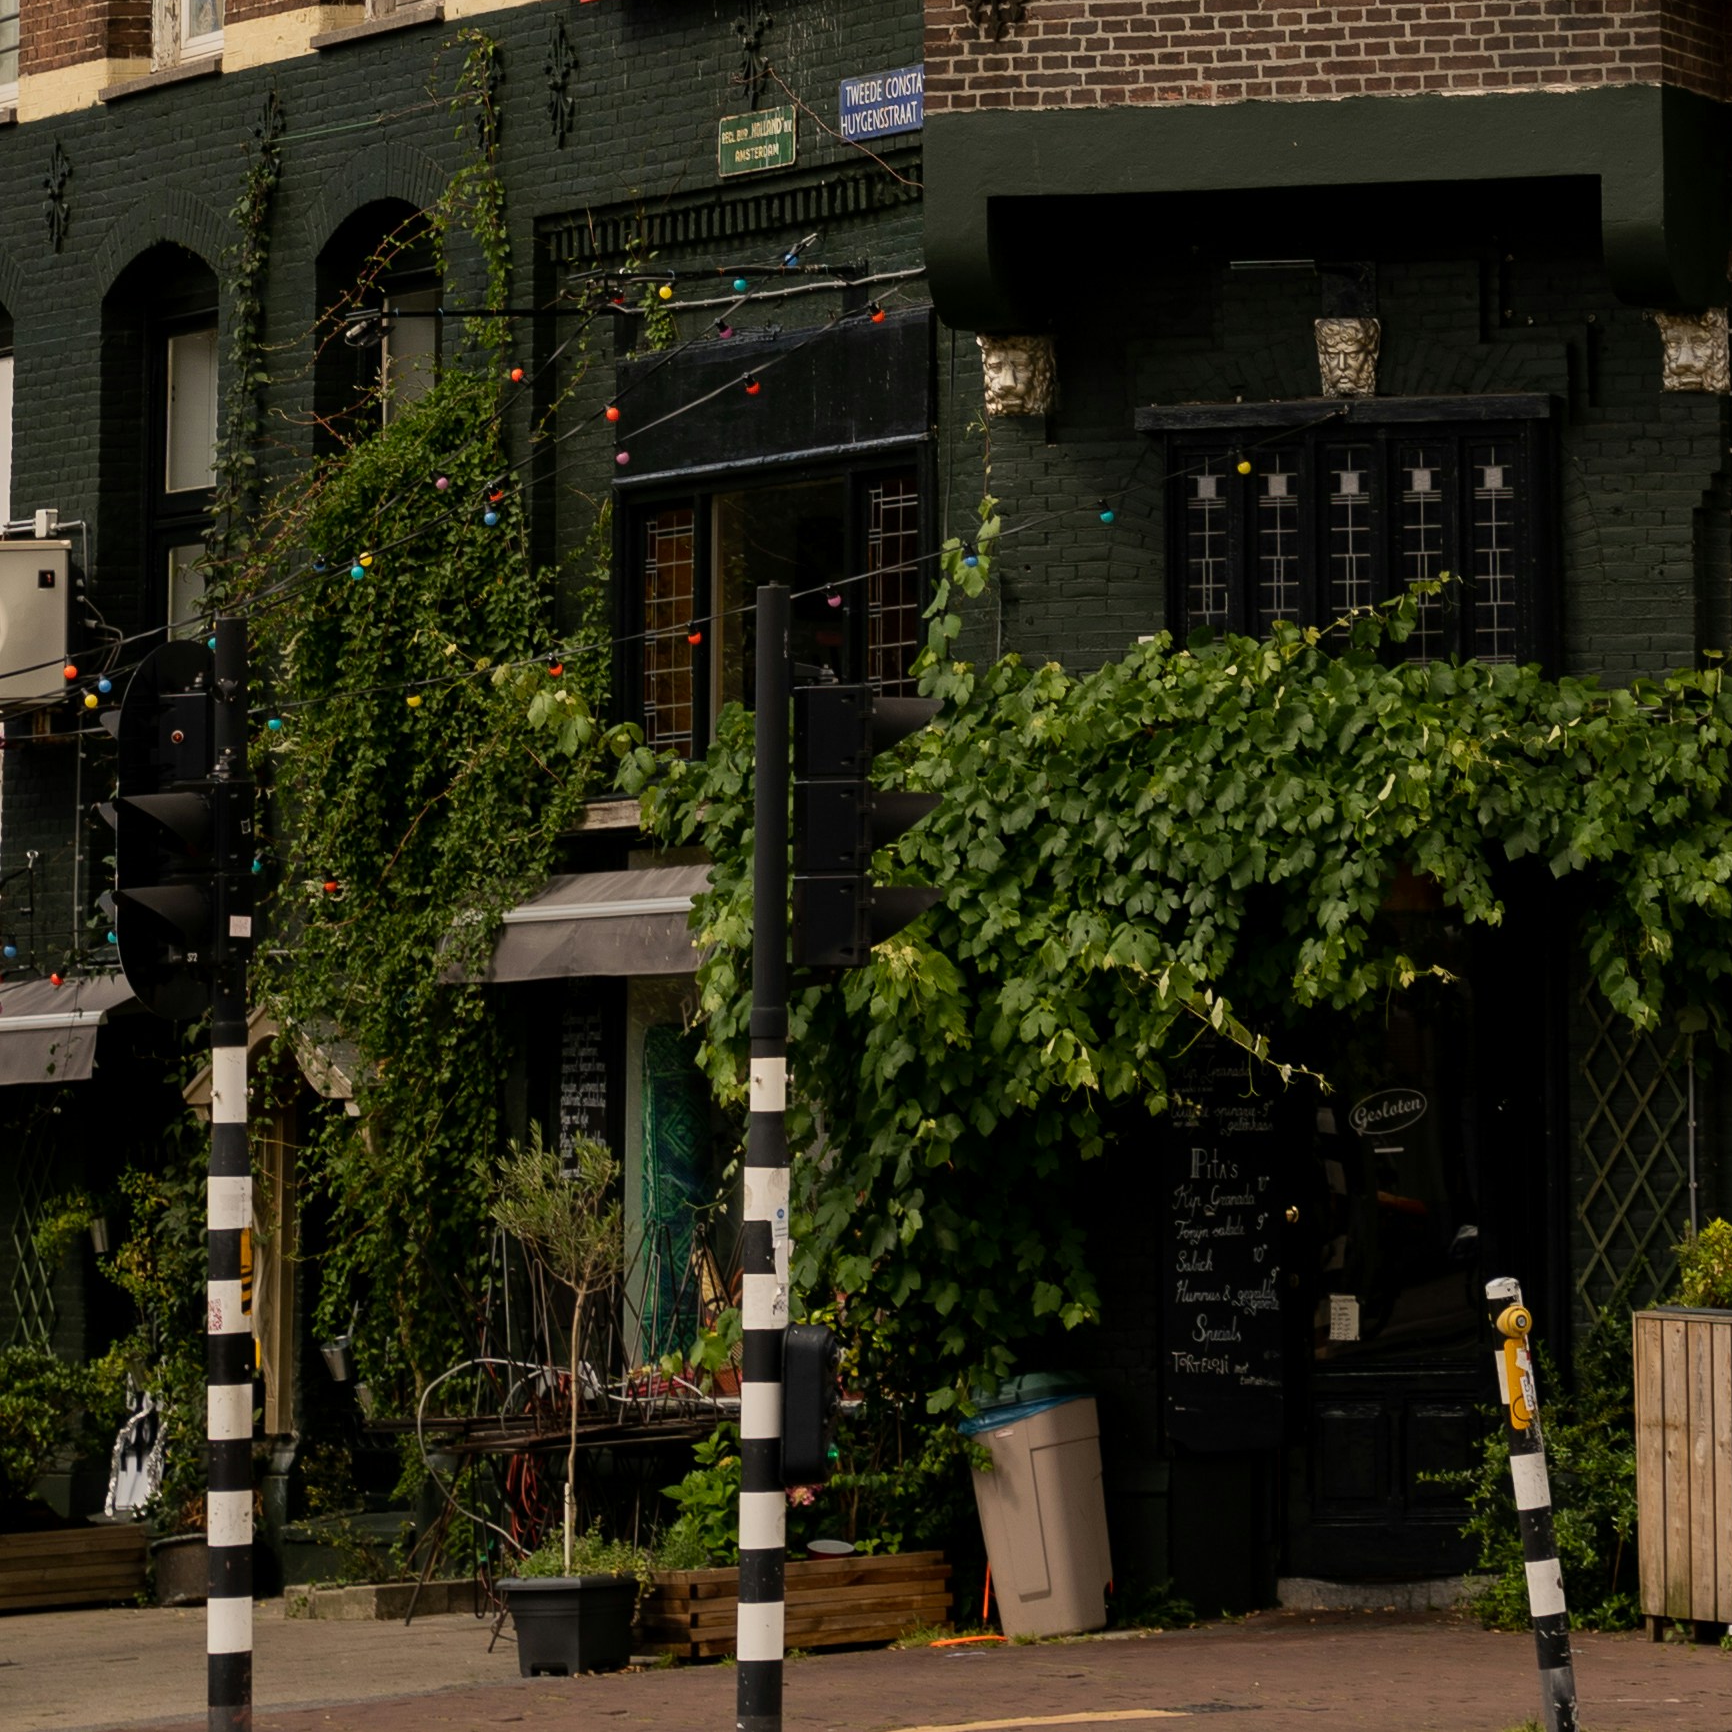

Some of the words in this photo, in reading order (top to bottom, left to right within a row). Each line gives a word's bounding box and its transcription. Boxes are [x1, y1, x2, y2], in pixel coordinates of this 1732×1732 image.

[845, 79, 883, 107] TWEEDE
[886, 72, 924, 99] CONSTA
[841, 101, 918, 136] HUYGENSSTRAAT
[735, 142, 779, 163] AMSTERDAM
[1354, 1097, 1422, 1127] Gesloten
[1172, 1183, 1202, 1217] Kip
[1203, 1182, 1255, 1209] Granada
[1211, 1214, 1246, 1237] salade
[1191, 1313, 1242, 1353] Specials
